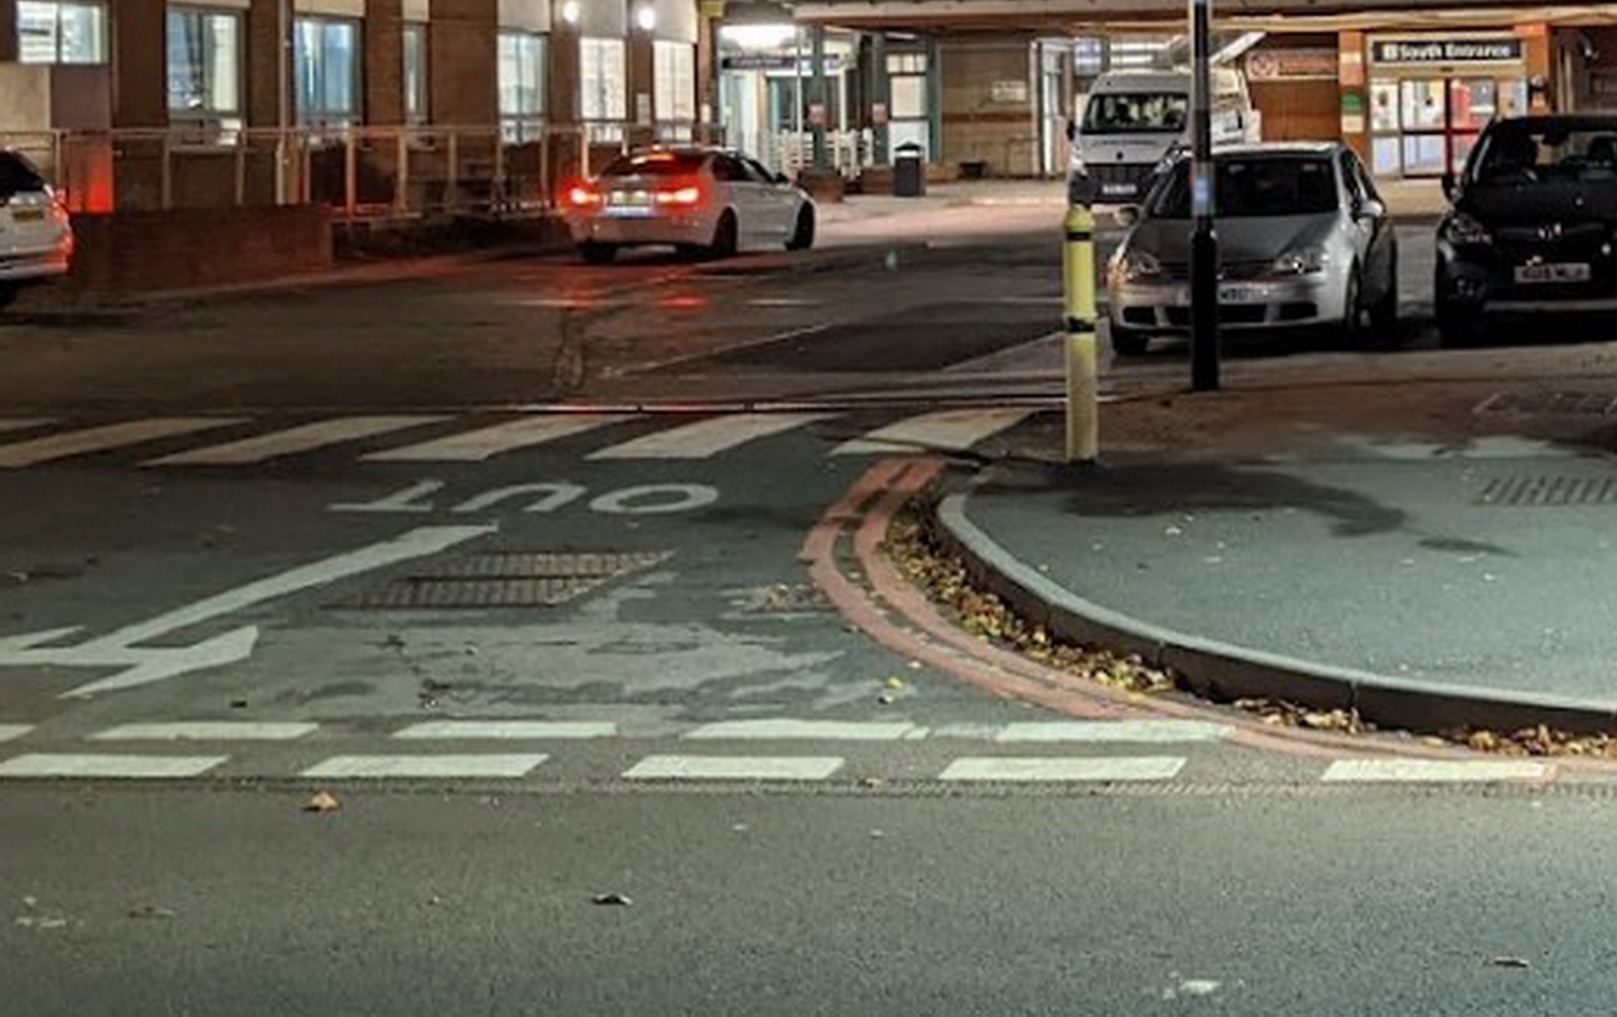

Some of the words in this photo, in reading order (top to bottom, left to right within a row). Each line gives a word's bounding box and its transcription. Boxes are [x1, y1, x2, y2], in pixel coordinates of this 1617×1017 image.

[1401, 44, 1442, 59] South
[1445, 44, 1512, 58] Entrance
[327, 481, 719, 513] OUT
